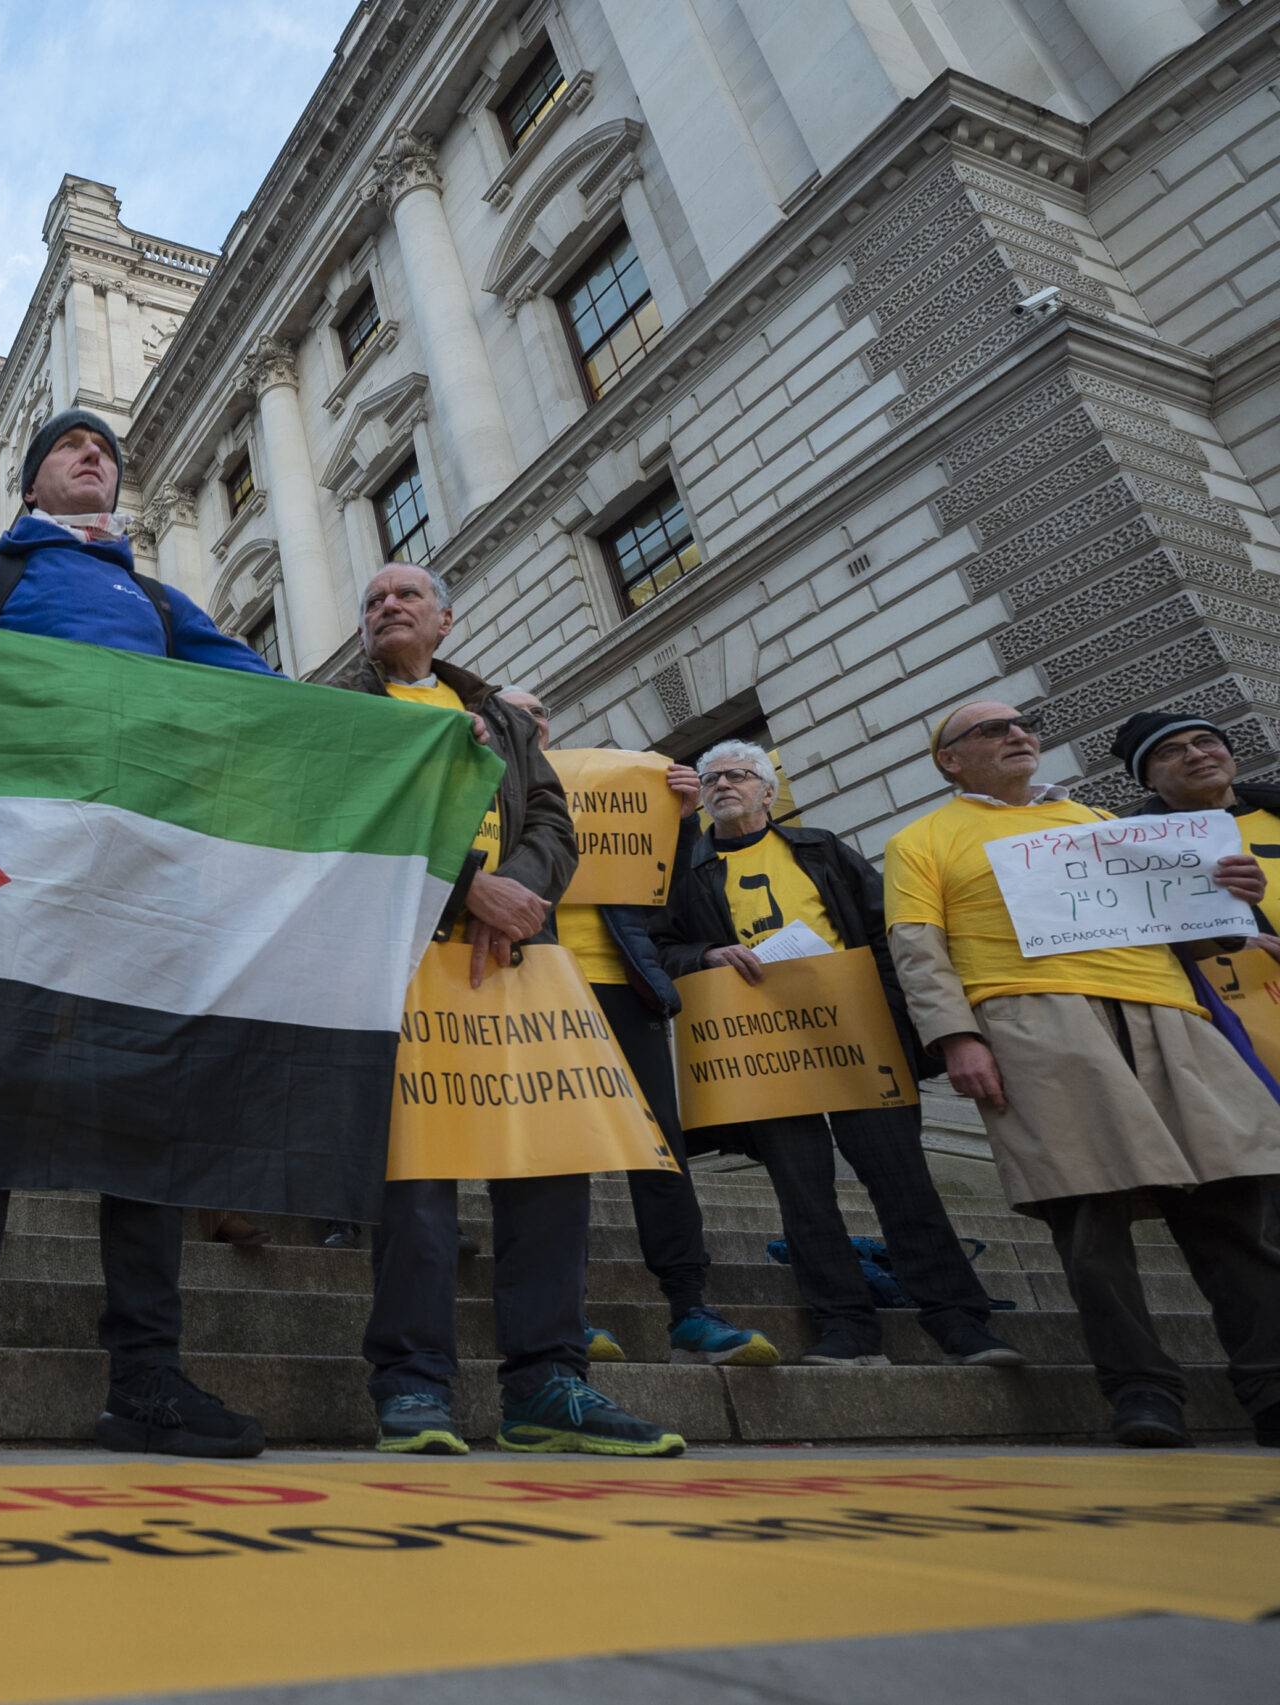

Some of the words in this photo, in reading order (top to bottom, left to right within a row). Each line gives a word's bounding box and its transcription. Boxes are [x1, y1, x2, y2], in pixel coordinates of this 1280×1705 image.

[1026, 936, 1044, 949] NO
[1050, 927, 1130, 945] DEMOCRACY
[1136, 924, 1172, 934] WITH
[400, 1011, 431, 1043] NO
[435, 1011, 460, 1044] TO
[463, 1009, 610, 1046] NETANYAHU
[691, 1018, 720, 1044] NO
[723, 1005, 839, 1038] DEMOCRACY
[690, 1058, 742, 1084] WITH
[744, 1044, 866, 1077] OCCUPATION
[399, 1071, 437, 1105] NO
[441, 1072, 466, 1106] TO
[471, 1065, 634, 1107] OCCUPATION
